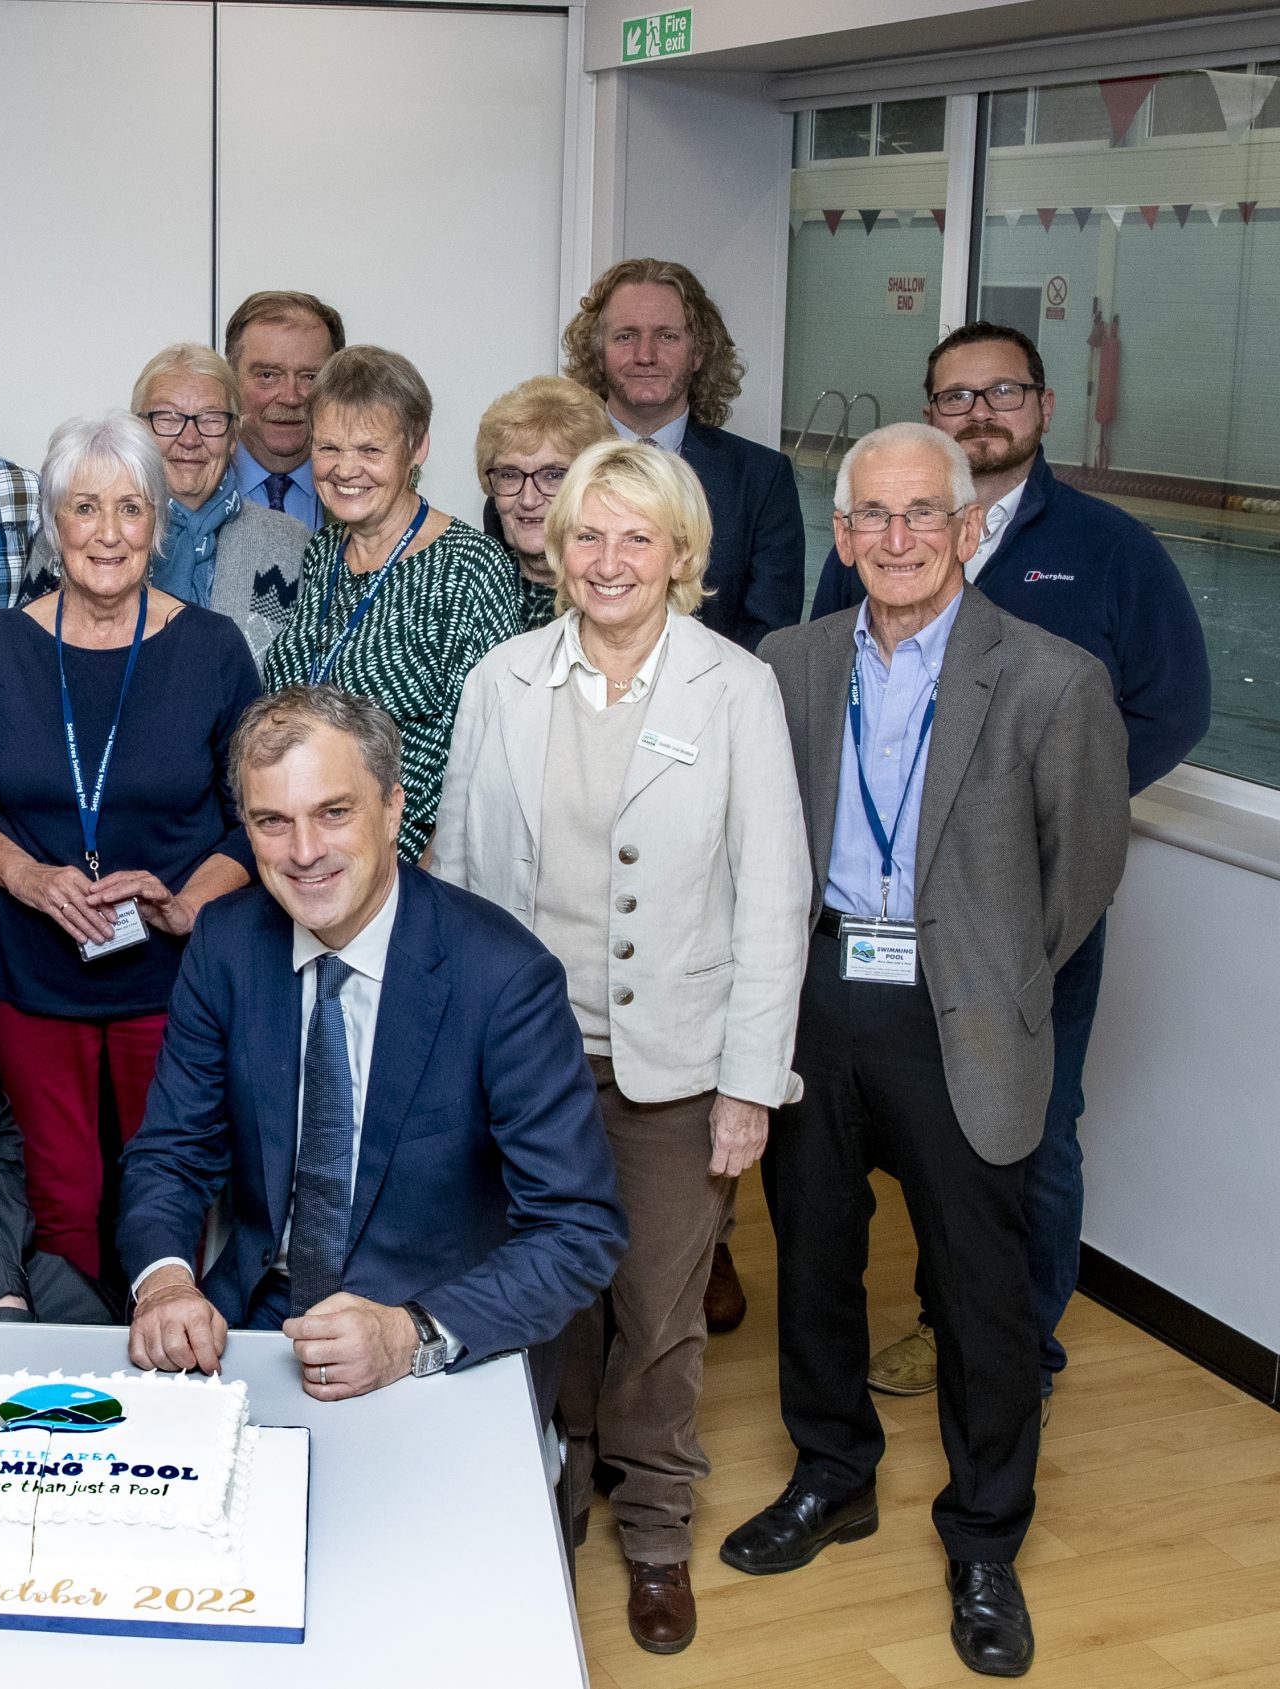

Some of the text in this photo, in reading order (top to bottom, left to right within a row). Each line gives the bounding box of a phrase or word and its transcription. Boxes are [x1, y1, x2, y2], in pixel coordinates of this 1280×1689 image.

[665, 14, 686, 33] Fire
[665, 32, 685, 52] exit
[887, 276, 925, 292] SHALLOW
[897, 295, 913, 311] END
[366, 528, 414, 600] Settle Area Swimming Pool
[1039, 572, 1074, 581] berghaus
[851, 685, 859, 706] Settle
[66, 722, 88, 809] Settle Area Swimming Pool
[99, 740, 113, 773] Swimming
[95, 774, 104, 791] Area
[90, 791, 100, 812] Settle
[876, 946, 914, 955] SWIMMING
[62, 1452, 117, 1461] AREA
[109, 1462, 199, 1481] POOL
[21, 1479, 66, 1495] than
[66, 1480, 106, 1497] just
[109, 1484, 120, 1494] a
[129, 1483, 170, 1497] Pool
[133, 1585, 257, 1614] 2022
